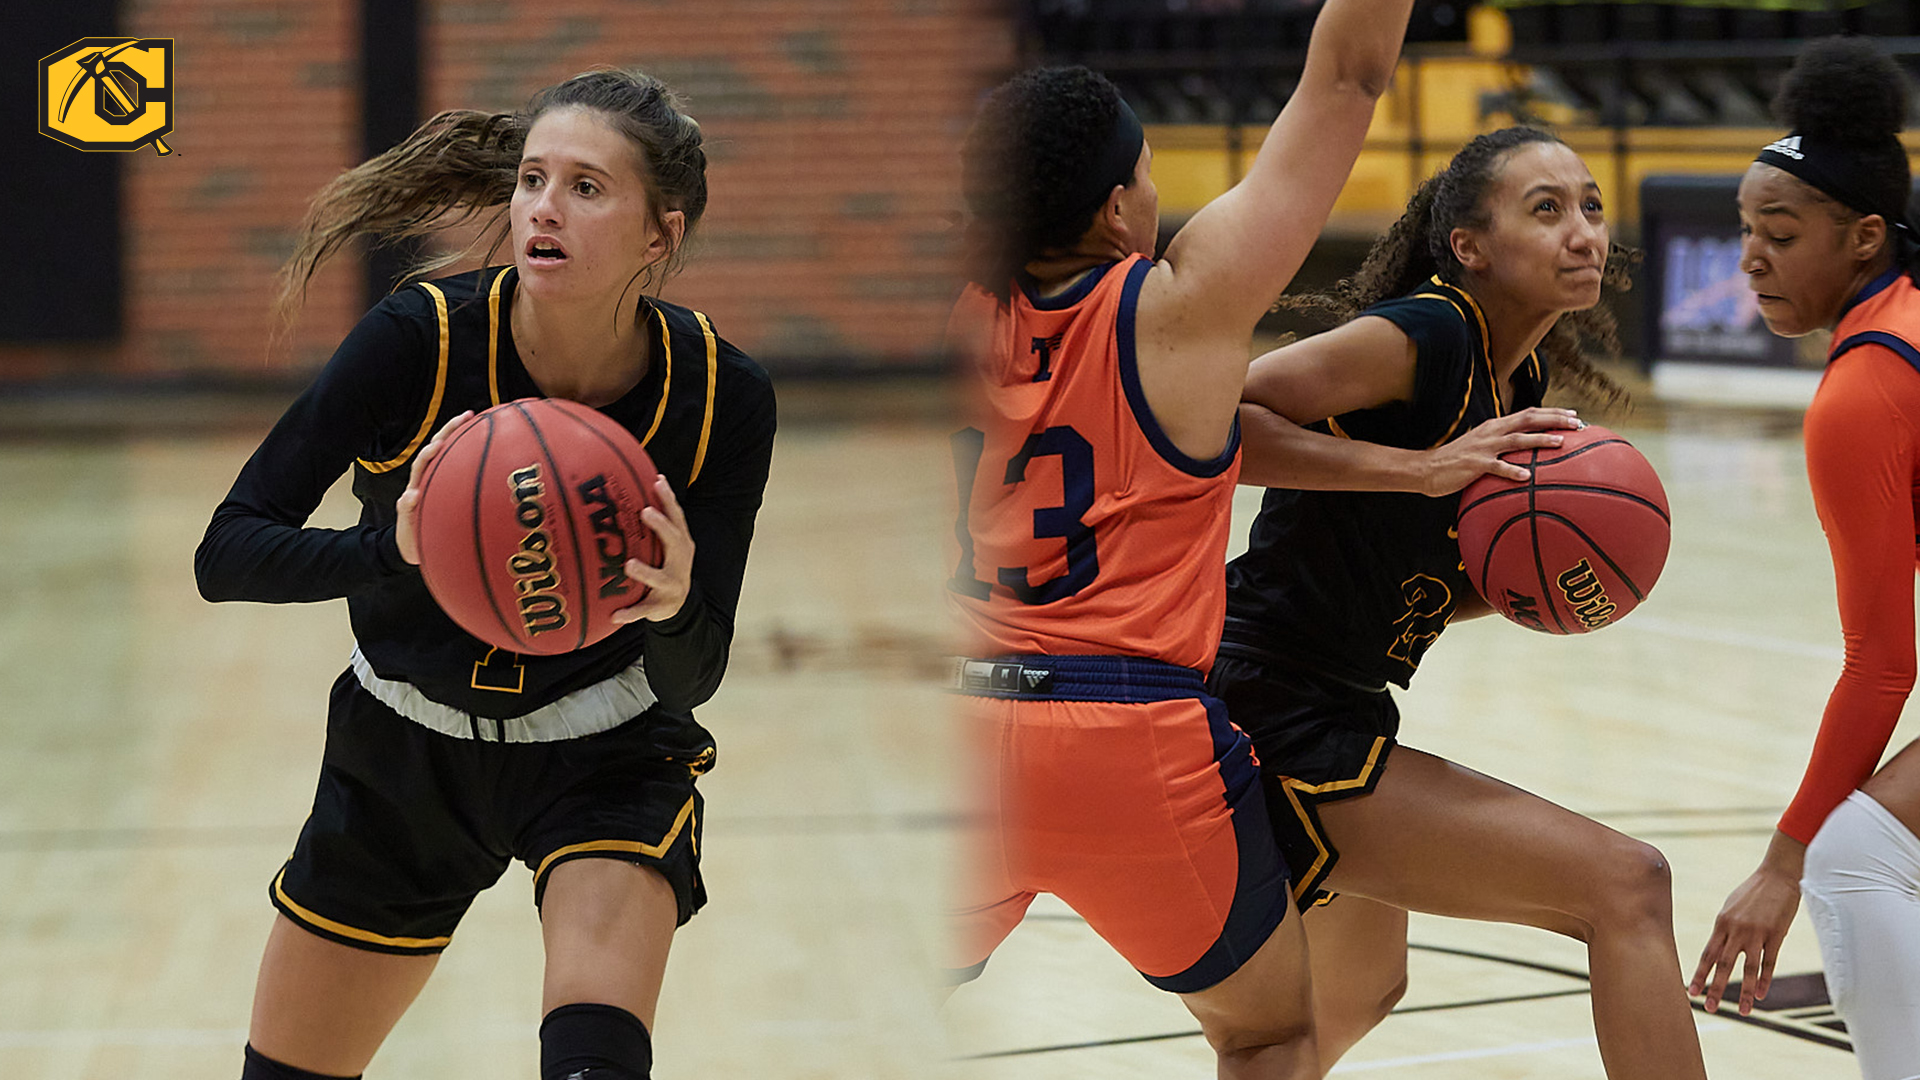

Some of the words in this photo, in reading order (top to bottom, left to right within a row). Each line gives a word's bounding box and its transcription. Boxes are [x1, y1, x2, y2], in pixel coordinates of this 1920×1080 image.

[506, 463, 570, 637] Wilson
[577, 474, 628, 599] NCAA
[947, 426, 1100, 606] 13
